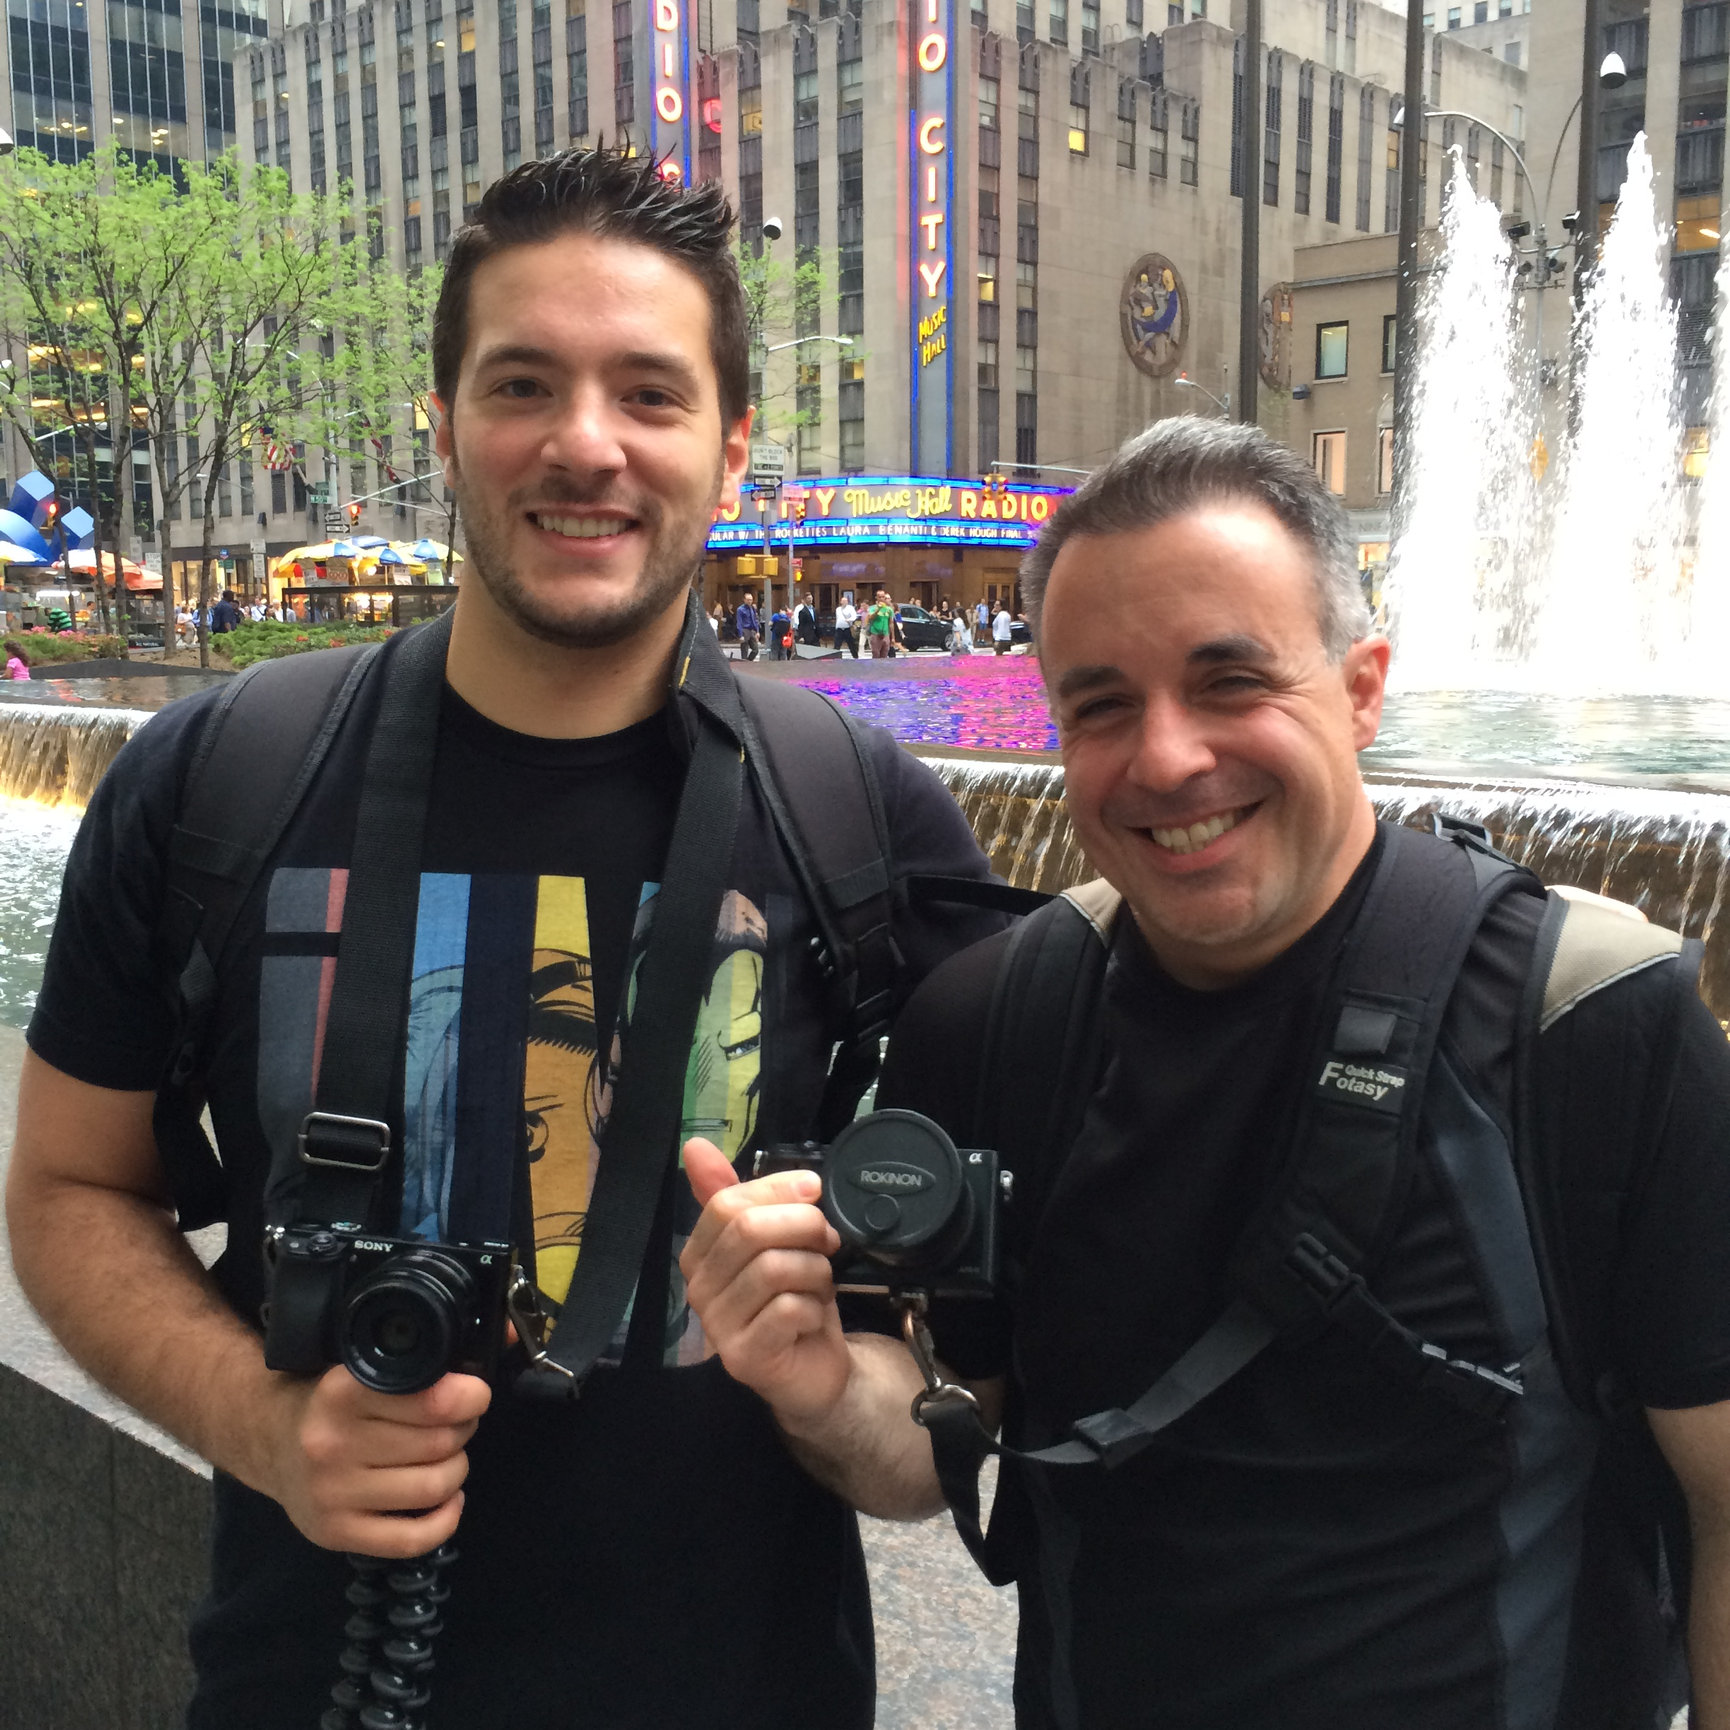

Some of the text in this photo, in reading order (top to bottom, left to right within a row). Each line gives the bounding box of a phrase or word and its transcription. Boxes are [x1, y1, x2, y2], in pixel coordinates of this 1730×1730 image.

[918, 116, 946, 298] CITY
[918, 305, 947, 344] MUSIC
[922, 333, 947, 367] HALL
[843, 488, 911, 518] Music
[906, 485, 952, 519] Hall
[960, 490, 1048, 521] RADIO
[832, 525, 871, 536] LAURA
[878, 525, 927, 536] BENANTI
[941, 526, 966, 537] DEREK
[969, 527, 998, 538] HOUGH
[1001, 527, 1022, 539] FINAL
[1318, 1061, 1389, 1101] Fotasy
[860, 1170, 922, 1187] ROKINON
[354, 1240, 394, 1252] SONY
